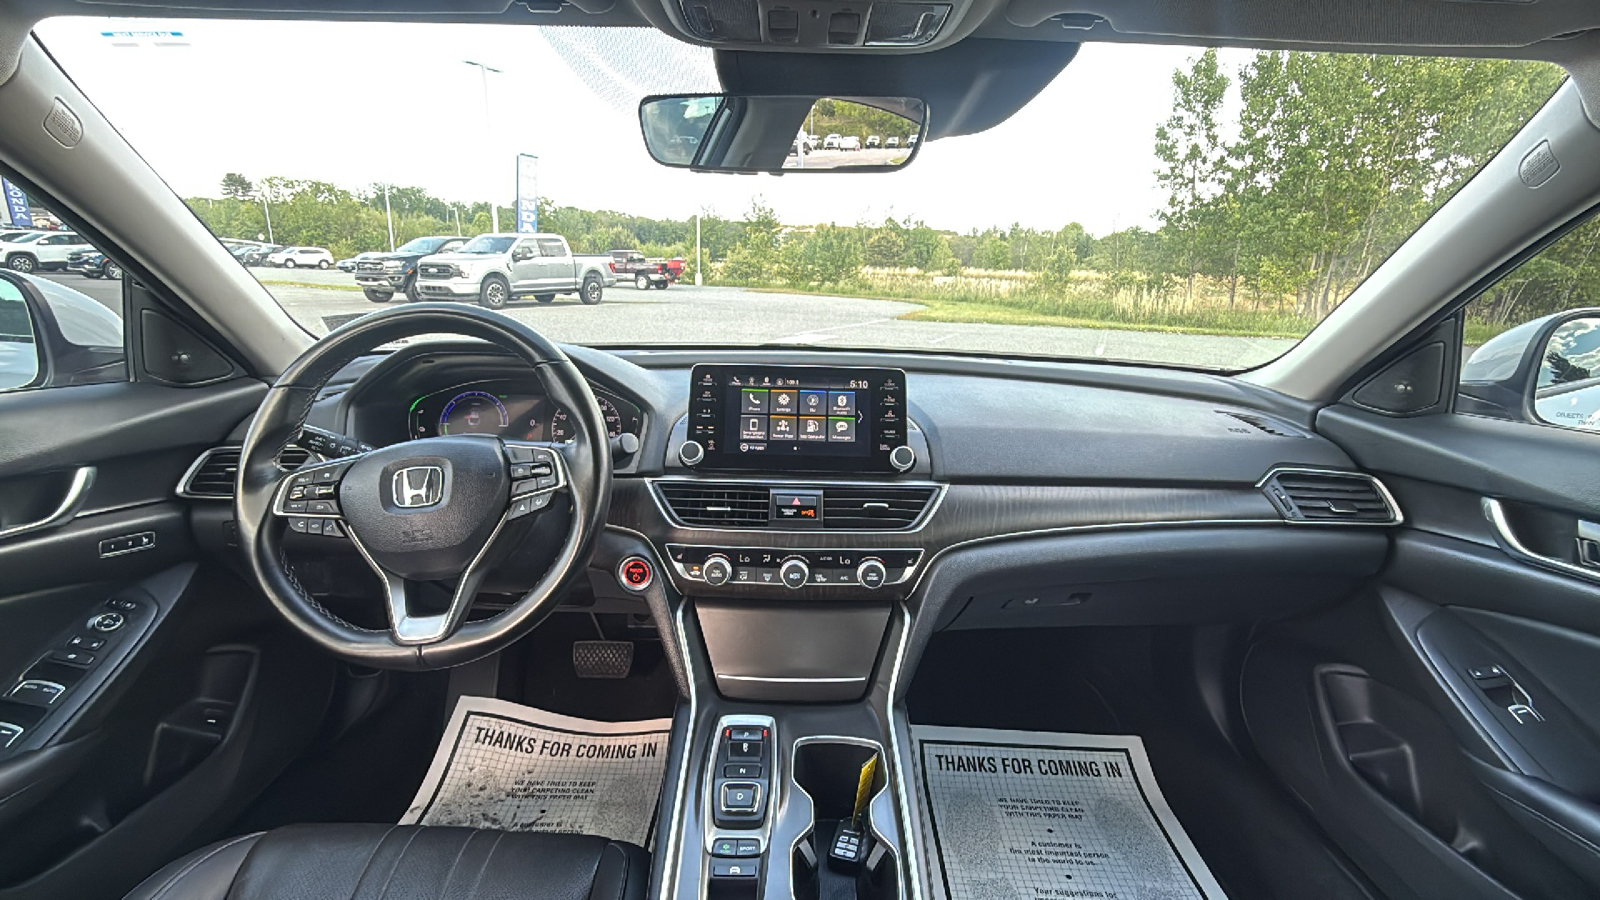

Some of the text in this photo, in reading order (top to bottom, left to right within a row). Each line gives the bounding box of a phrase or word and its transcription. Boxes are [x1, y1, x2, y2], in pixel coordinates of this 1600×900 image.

[850, 380, 868, 388] 5:10
[739, 554, 750, 563] Lo
[840, 556, 850, 565] Lo
[475, 726, 658, 759] THANKS FOR COMING IN
[935, 754, 1122, 778] THANKS FOR COMING IN
[1045, 850, 1081, 858] important
[1055, 889, 1103, 898] suggestions
